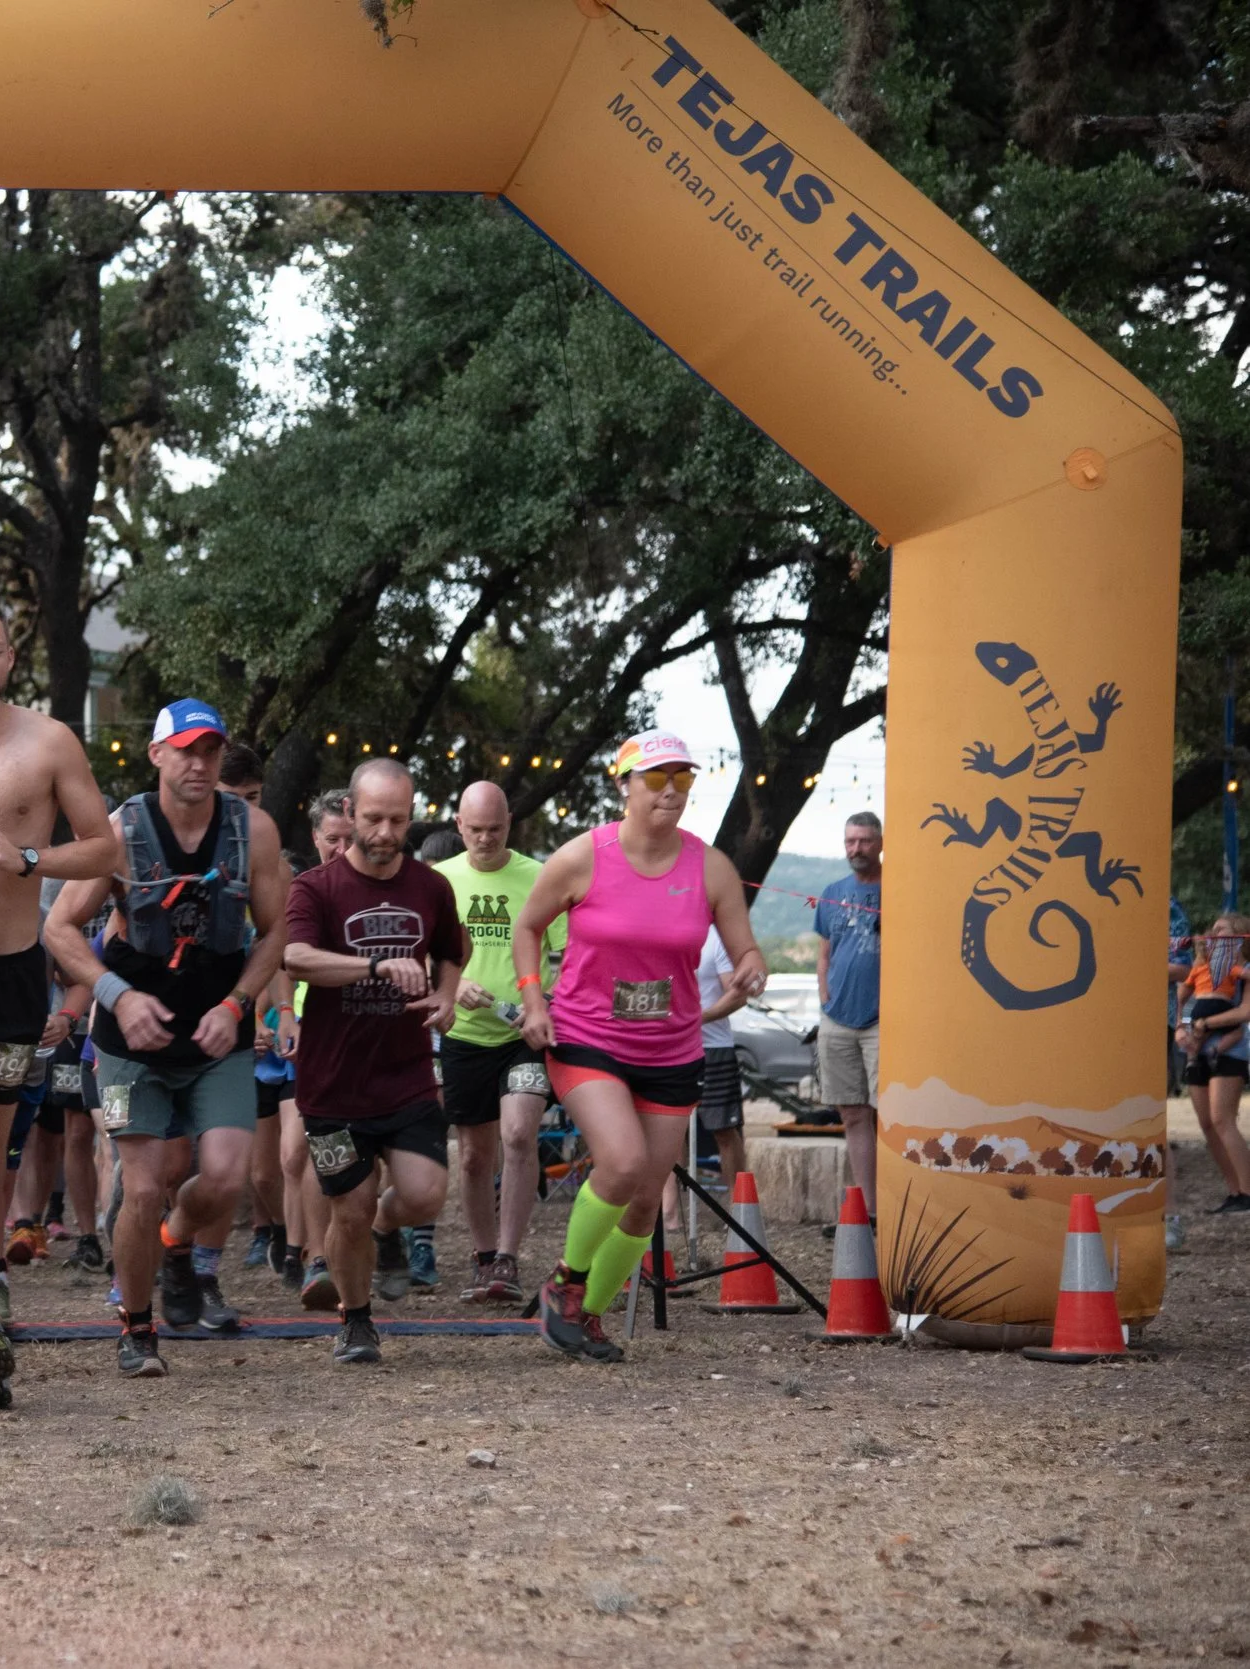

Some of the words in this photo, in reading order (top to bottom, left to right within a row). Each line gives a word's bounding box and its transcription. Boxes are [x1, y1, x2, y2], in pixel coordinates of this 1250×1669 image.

[651, 35, 835, 225] TEJAS
[833, 212, 1044, 418] TRAILS
[606, 92, 664, 154] More
[665, 149, 717, 207] than
[710, 200, 763, 253] just
[763, 245, 812, 299] trail
[810, 293, 907, 396] running...
[1019, 670, 1088, 779] TEJAS
[973, 787, 1085, 906] TRAILS
[362, 915, 410, 937] BRC
[467, 926, 511, 940] ROGUE
[342, 985, 403, 1000] BRAZO
[625, 992, 659, 1012] 181
[342, 1001, 406, 1016] RUNNER
[56, 1073, 82, 1088] 200
[515, 1072, 545, 1088] 192
[313, 1145, 351, 1168] 202
